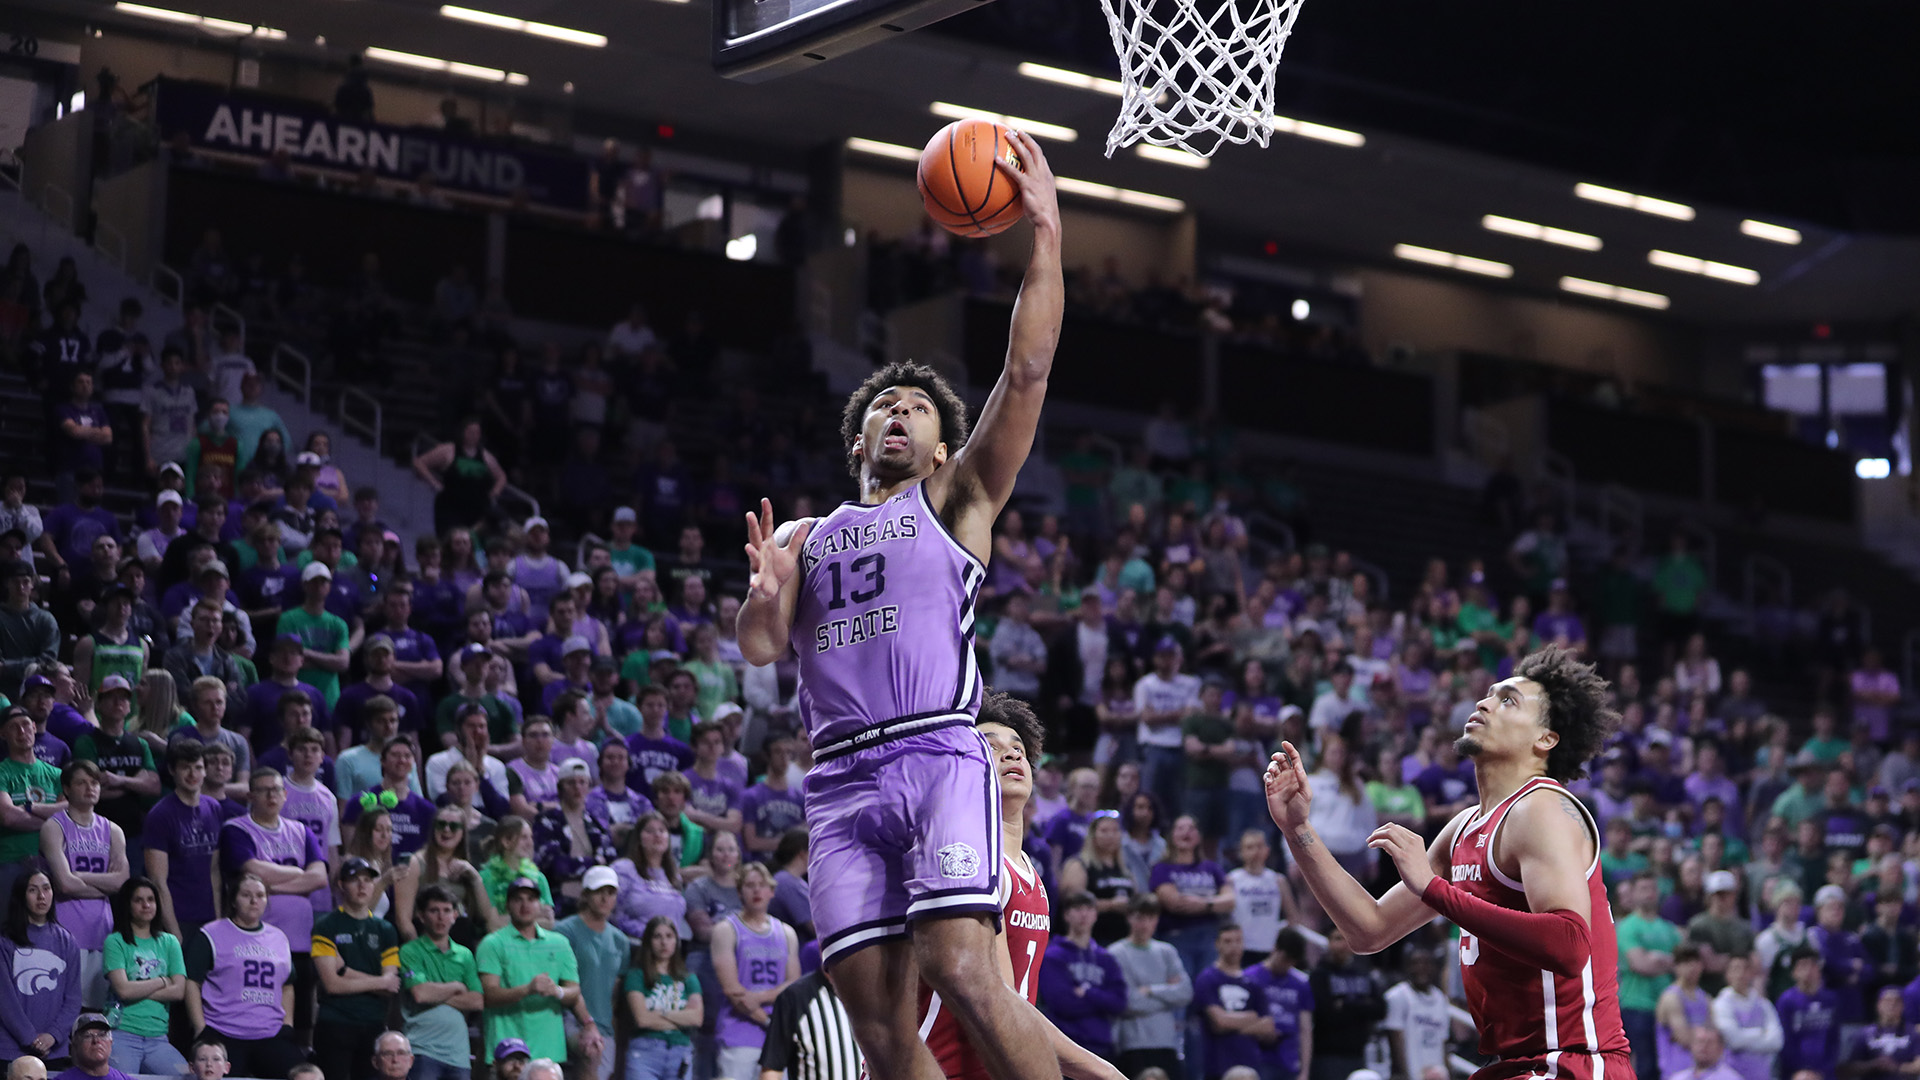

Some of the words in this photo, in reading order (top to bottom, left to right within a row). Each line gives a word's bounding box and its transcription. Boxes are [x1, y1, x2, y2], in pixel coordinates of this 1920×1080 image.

[9, 35, 39, 56] 20
[60, 337, 80, 363] 17
[804, 514, 918, 574] KANSAS
[827, 552, 886, 611] 13
[816, 606, 898, 654] STATE
[243, 960, 275, 989] 22
[751, 961, 779, 986] 25
[1018, 939, 1037, 1000] 1
